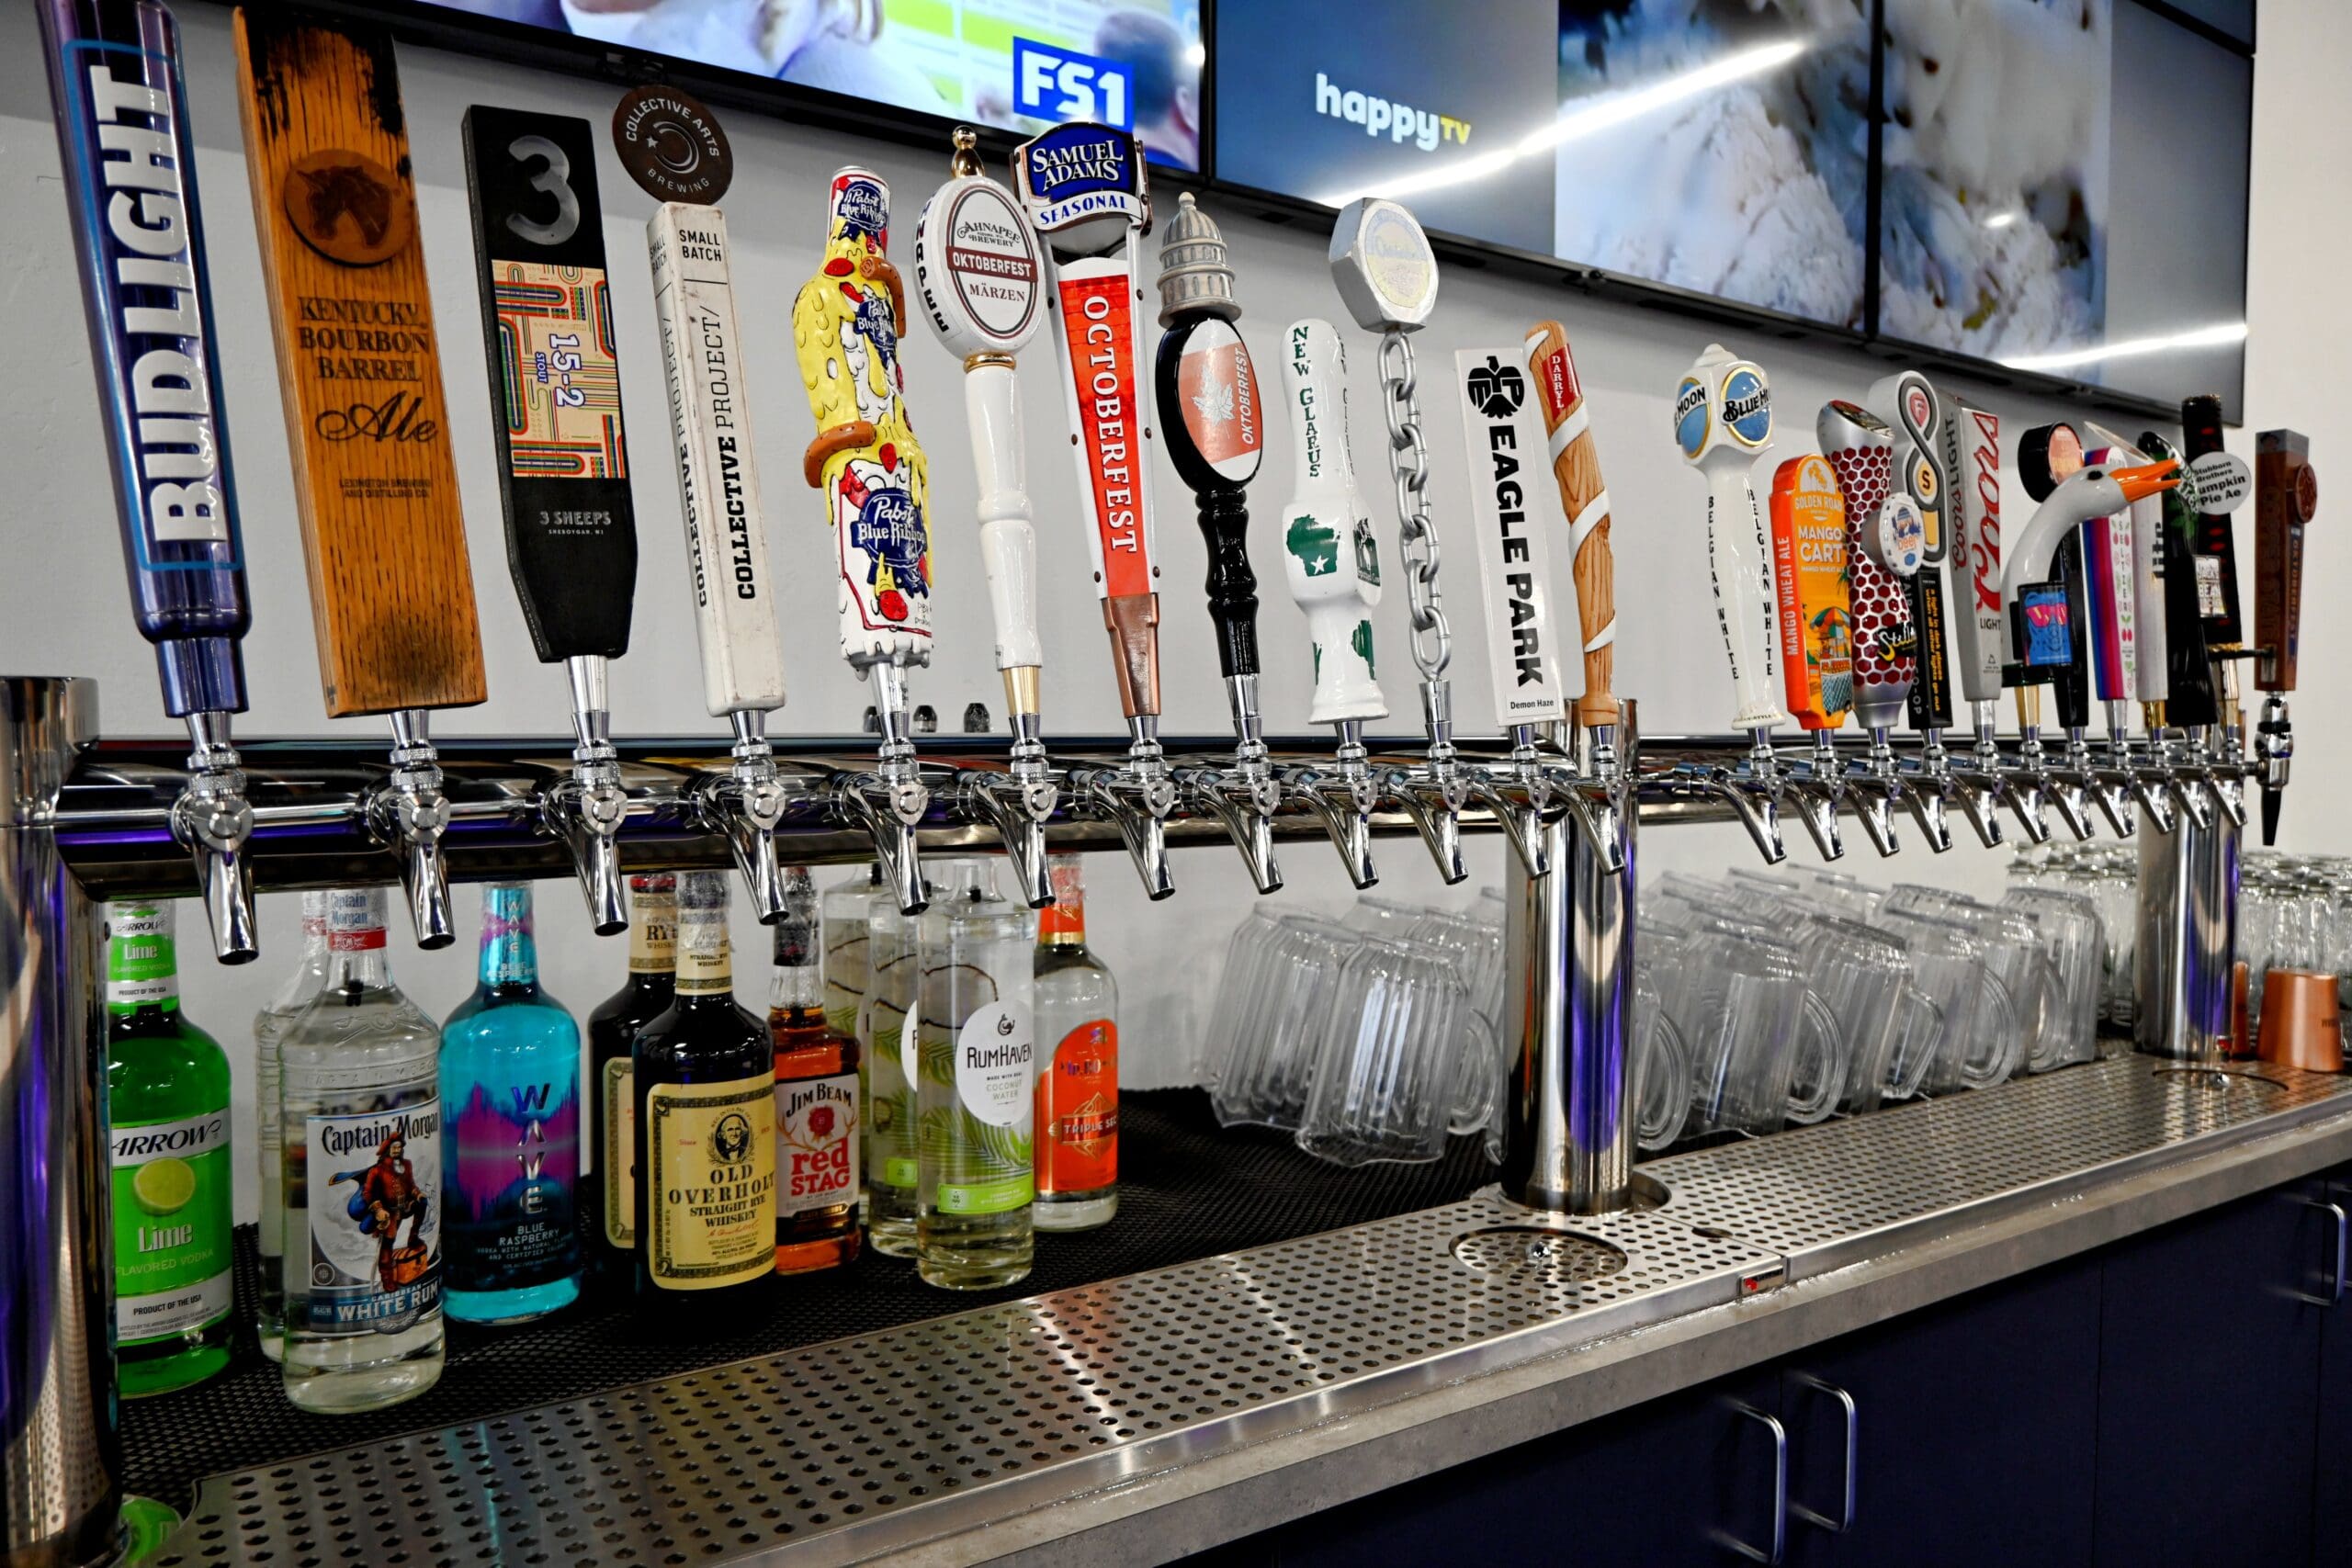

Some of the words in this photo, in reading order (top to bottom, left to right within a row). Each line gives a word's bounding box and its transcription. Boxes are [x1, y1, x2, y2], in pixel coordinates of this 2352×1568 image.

[1022, 50, 1125, 126] FS1
[627, 97, 692, 142] COLLECTIVE
[693, 118, 719, 157] ARTS
[1316, 73, 1471, 152] happyTV
[1032, 140, 1124, 173] SAMUEL
[506, 135, 580, 245] 3
[648, 168, 710, 194] BREWING
[1043, 160, 1119, 191] ADAMS
[89, 65, 193, 341] LIGHT
[1040, 195, 1127, 225] SEASONAL
[679, 230, 720, 246] SMALL
[957, 221, 1020, 243] AHNAPEE
[973, 236, 1013, 247] BREWERY
[682, 246, 722, 262] BATCH
[953, 253, 1031, 277] OKTOBERFEST
[969, 283, 1025, 301] MÄRZEN
[298, 297, 420, 326] KENTUCKY
[299, 327, 431, 354] BOURBON
[1292, 326, 1311, 377] NEW
[317, 356, 423, 382] BARREL
[536, 352, 548, 383] STOUT
[549, 333, 586, 407] 15-2
[1552, 355, 1564, 409] DARRYL
[1235, 347, 1255, 446] OKTOBERFEST
[1677, 387, 1706, 420] MOON
[315, 390, 438, 442] Ale
[1083, 296, 1137, 553] OCTOBERFEST
[131, 349, 228, 544] BUD
[1299, 387, 1320, 478] GLARUS
[1946, 420, 1959, 486] LIGHT
[1488, 425, 1530, 565] EAGLE
[1920, 470, 1930, 491] S
[2199, 475, 2246, 493] umpkin
[874, 497, 913, 525] Pabst
[1794, 496, 1822, 509] GOLDEN
[1973, 412, 2000, 612] Coors
[2200, 494, 2222, 506] Pie
[2225, 489, 2242, 501] Ae
[539, 511, 549, 525] 3
[553, 511, 612, 525] SHEEPS
[718, 436, 755, 600] COLLECTIVE
[1798, 525, 1842, 540] MANGO
[1952, 491, 1968, 570] Coors
[858, 524, 888, 542] Blue
[1778, 536, 1791, 559] ALE
[1800, 544, 1843, 562] CART
[1708, 496, 1720, 598] BELGIAN
[1717, 608, 1739, 680] WHITE
[1748, 490, 1770, 591] BELGIAN
[1763, 602, 1772, 676] WHITE
[1781, 565, 1794, 607] WHEAT
[1506, 573, 1543, 688] PARK
[1784, 611, 1798, 656] MANGO
[1980, 617, 2001, 632] LIGHT
[1510, 700, 1535, 709] Demon
[1537, 698, 1555, 707] Haze
[331, 892, 368, 910] Captain
[333, 910, 368, 927] Morgan
[124, 943, 158, 960] Lime
[987, 1079, 1022, 1091] COCONUT
[992, 1090, 1018, 1100] WATER
[786, 1089, 813, 1118] JIM
[817, 1083, 853, 1107] BEAM
[112, 1120, 221, 1156] ARROW
[322, 1120, 390, 1156] Captain
[392, 1112, 438, 1140] Morgan
[1064, 1121, 1103, 1134] TRIPLE
[509, 1083, 551, 1215] WAVE
[791, 1137, 850, 1176] red
[669, 1170, 775, 1204] OVERHOLT
[710, 1164, 752, 1185] OLD
[791, 1168, 850, 1197] STAG
[690, 1201, 749, 1217] STRAIGHT
[750, 1194, 766, 1207] RYE
[706, 1209, 757, 1227] WHISKEY
[139, 1224, 194, 1254] Lime
[499, 1229, 559, 1246] RASPBERRY
[517, 1223, 545, 1235] BLUE
[506, 1249, 544, 1259] CERTIFIED
[524, 1242, 550, 1250] NATURAL
[116, 1258, 176, 1276] FLAVORED
[180, 1248, 214, 1265] VODKA
[133, 1303, 165, 1316] PRODUCT
[167, 1301, 175, 1310] OF
[176, 1297, 188, 1306] THE
[190, 1294, 202, 1303] USA
[337, 1298, 406, 1322] WHITE
[411, 1282, 438, 1308] RUM
[371, 1284, 422, 1303] CARIBBEAN
